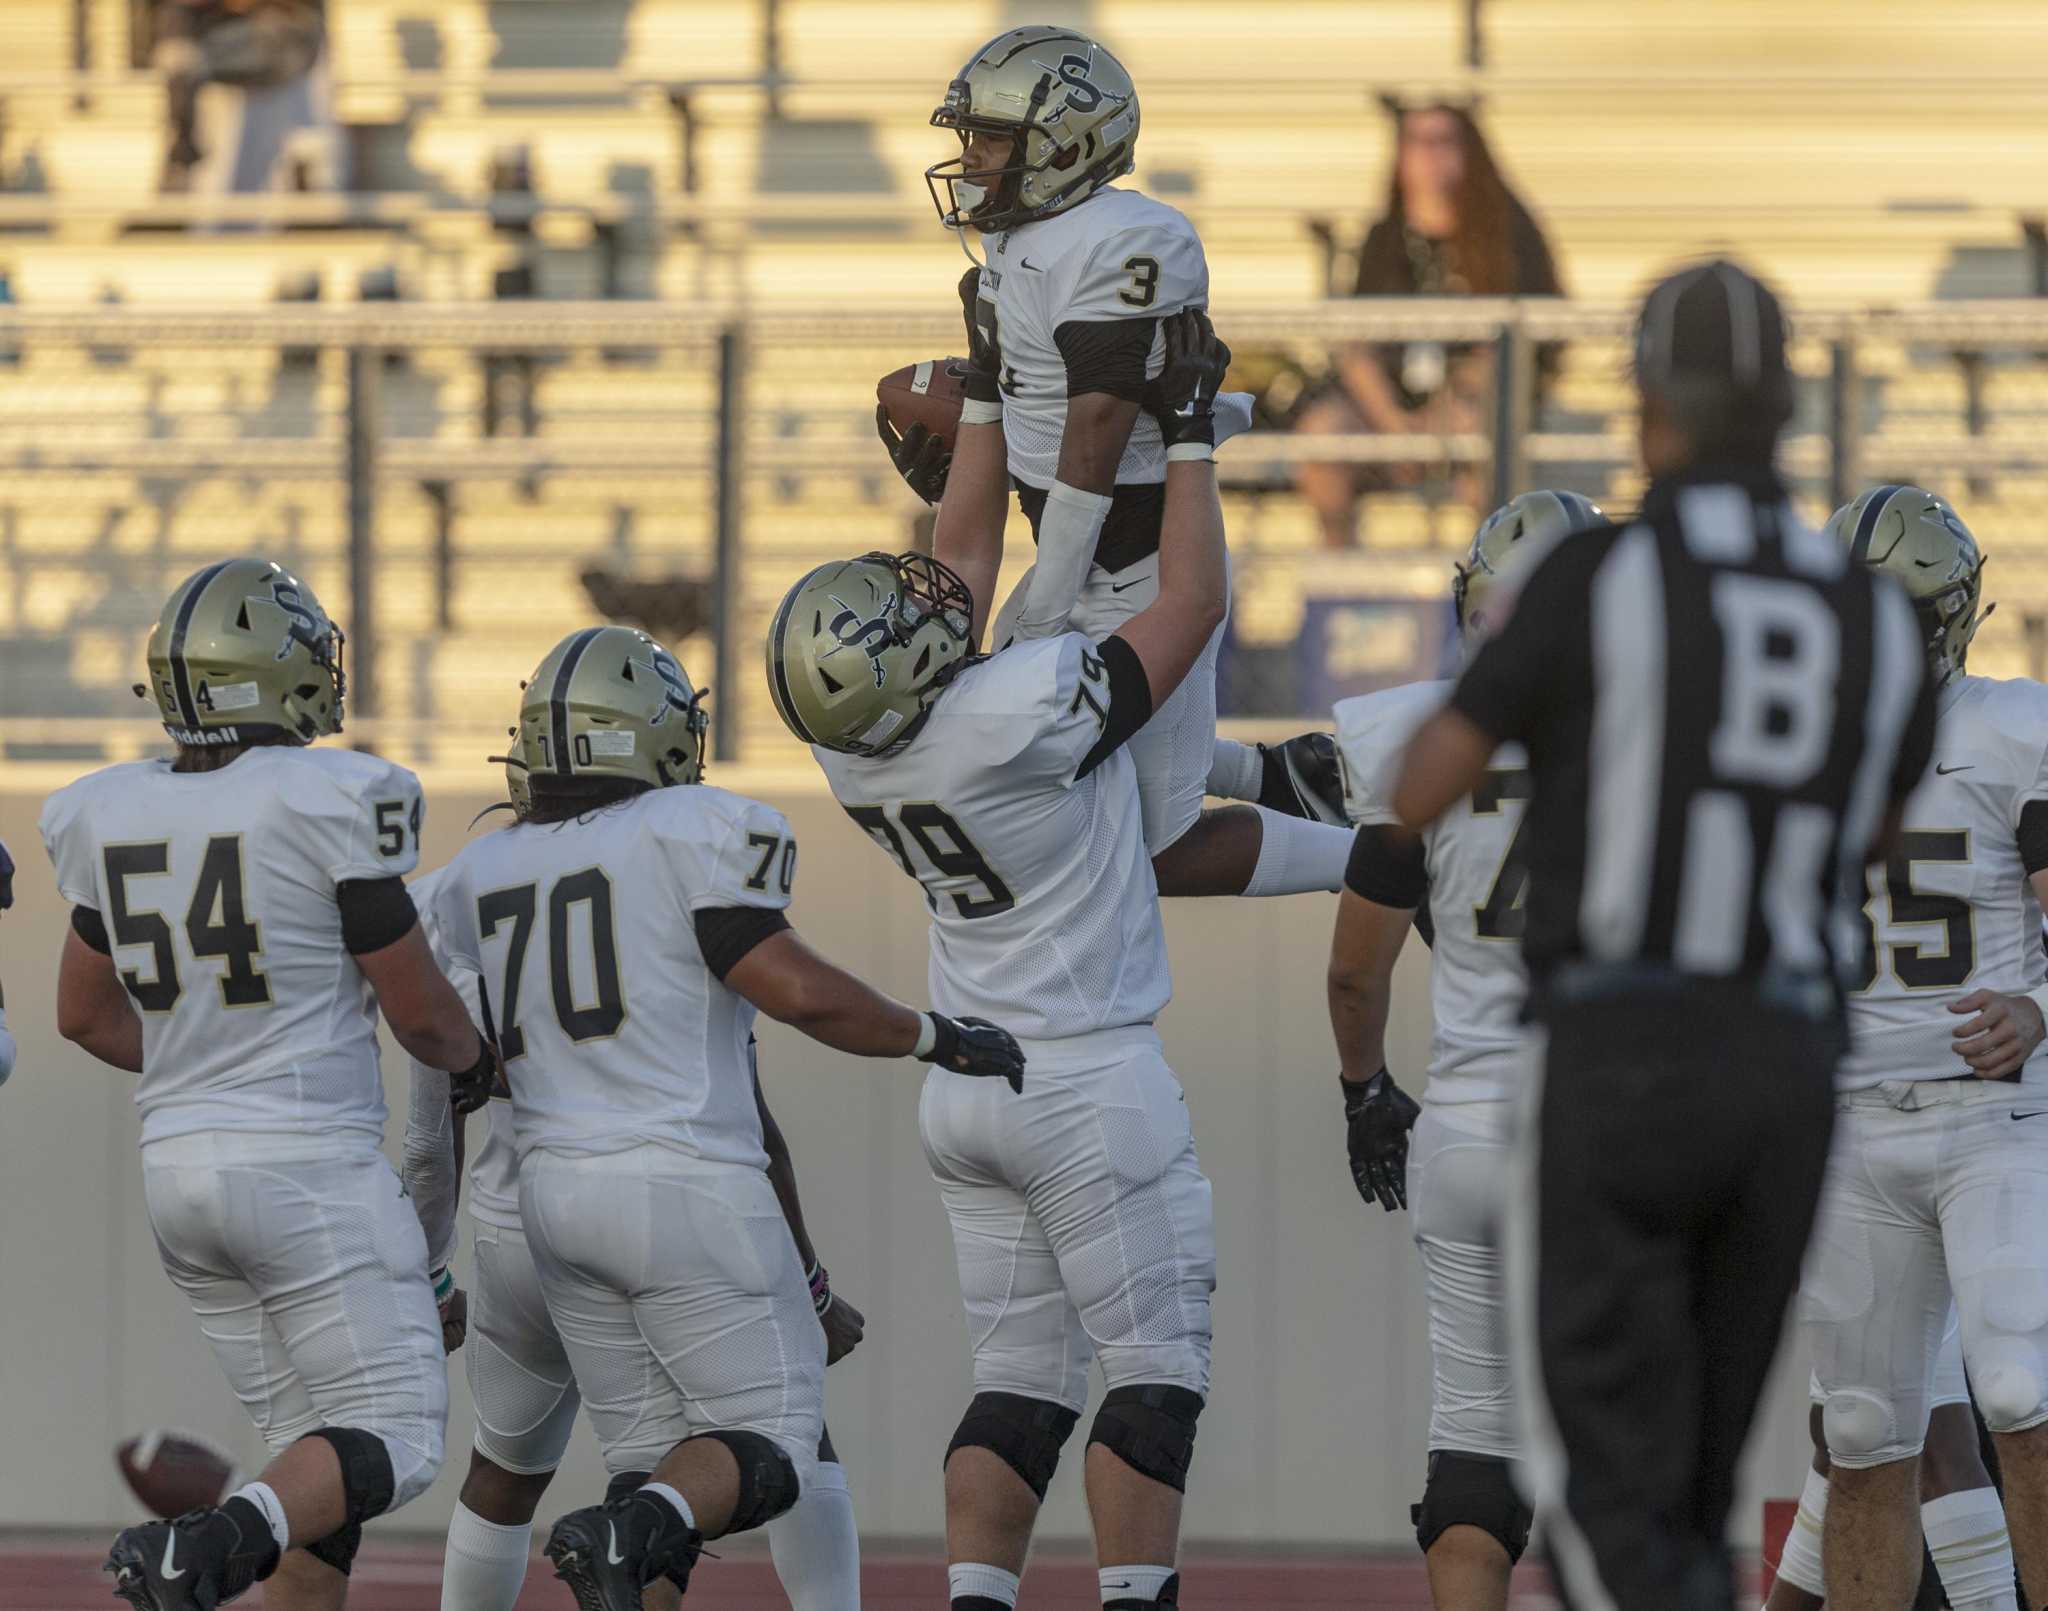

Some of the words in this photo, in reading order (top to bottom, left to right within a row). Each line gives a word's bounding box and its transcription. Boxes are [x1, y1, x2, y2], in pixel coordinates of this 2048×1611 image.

[1116, 255, 1162, 310] 3
[1708, 570, 1842, 790] B
[375, 797, 421, 861] 54
[743, 830, 797, 896] 70
[101, 832, 274, 1015] 54
[476, 864, 631, 1064] 70
